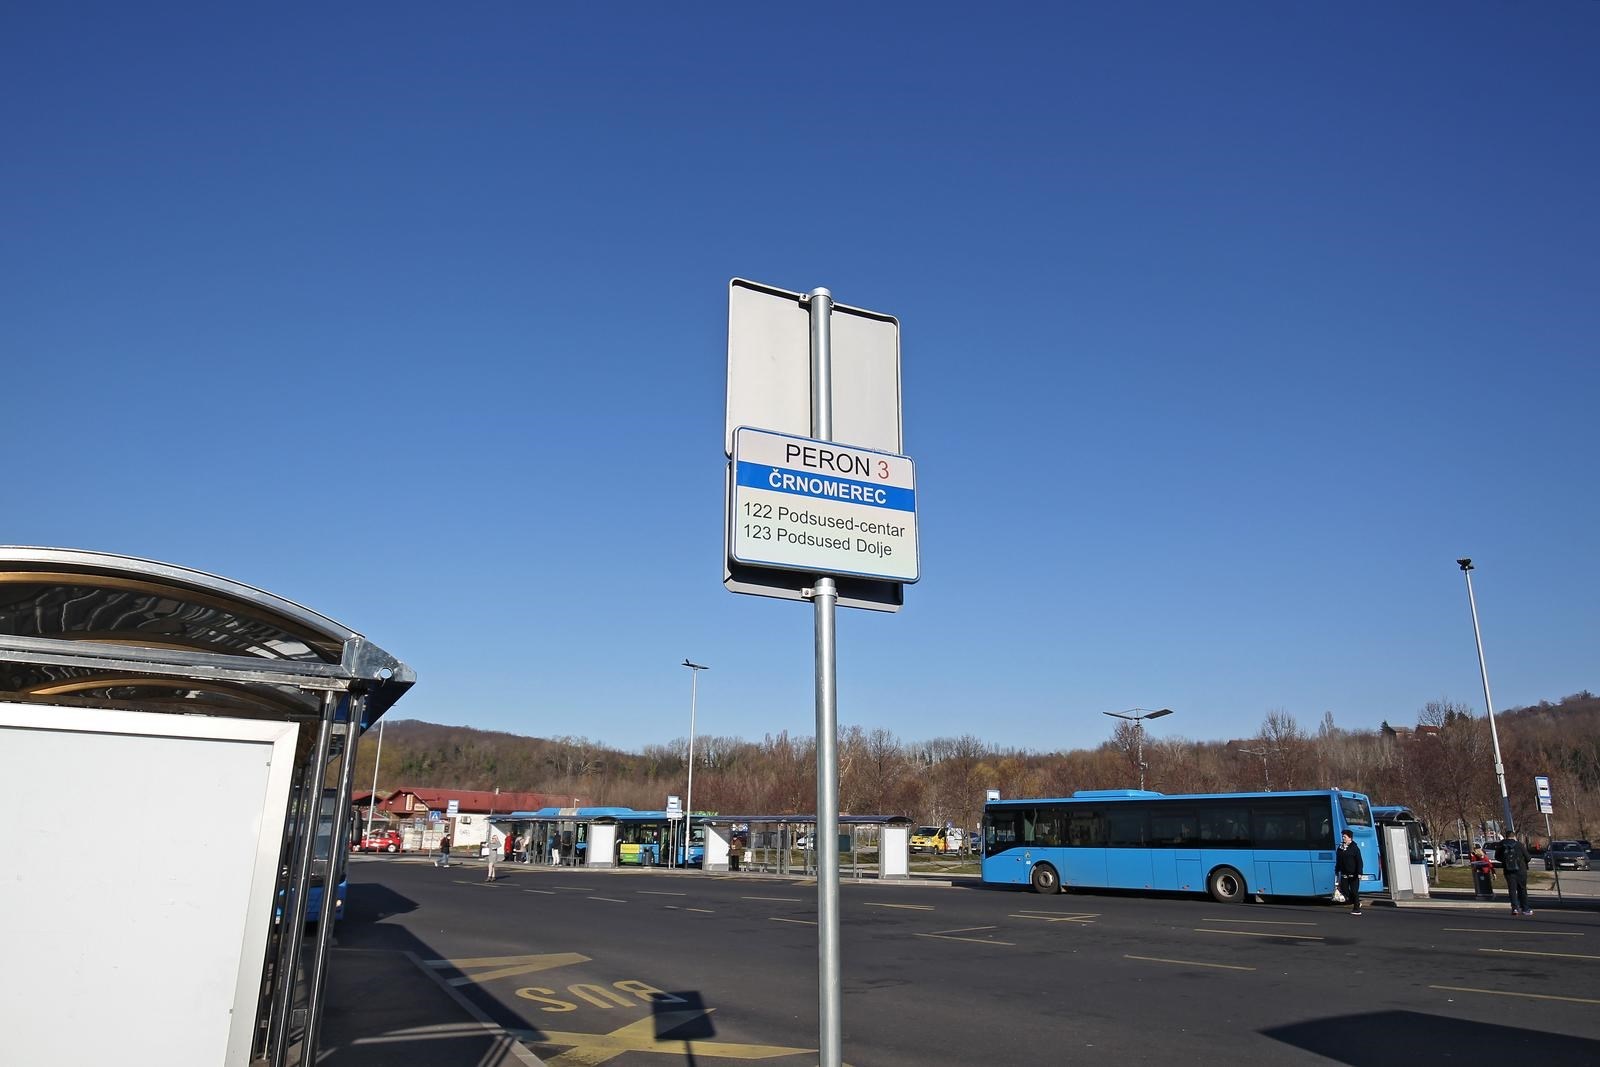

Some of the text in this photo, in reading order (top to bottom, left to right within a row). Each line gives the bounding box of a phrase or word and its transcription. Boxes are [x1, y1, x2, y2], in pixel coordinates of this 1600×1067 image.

[786, 443, 890, 480] PERON 3
[768, 468, 887, 504] ČRNOMEREC
[743, 502, 906, 538] 122 Podsused-centar
[743, 524, 893, 558] 123 Podsused Dolje
[514, 979, 688, 1013] BUS
